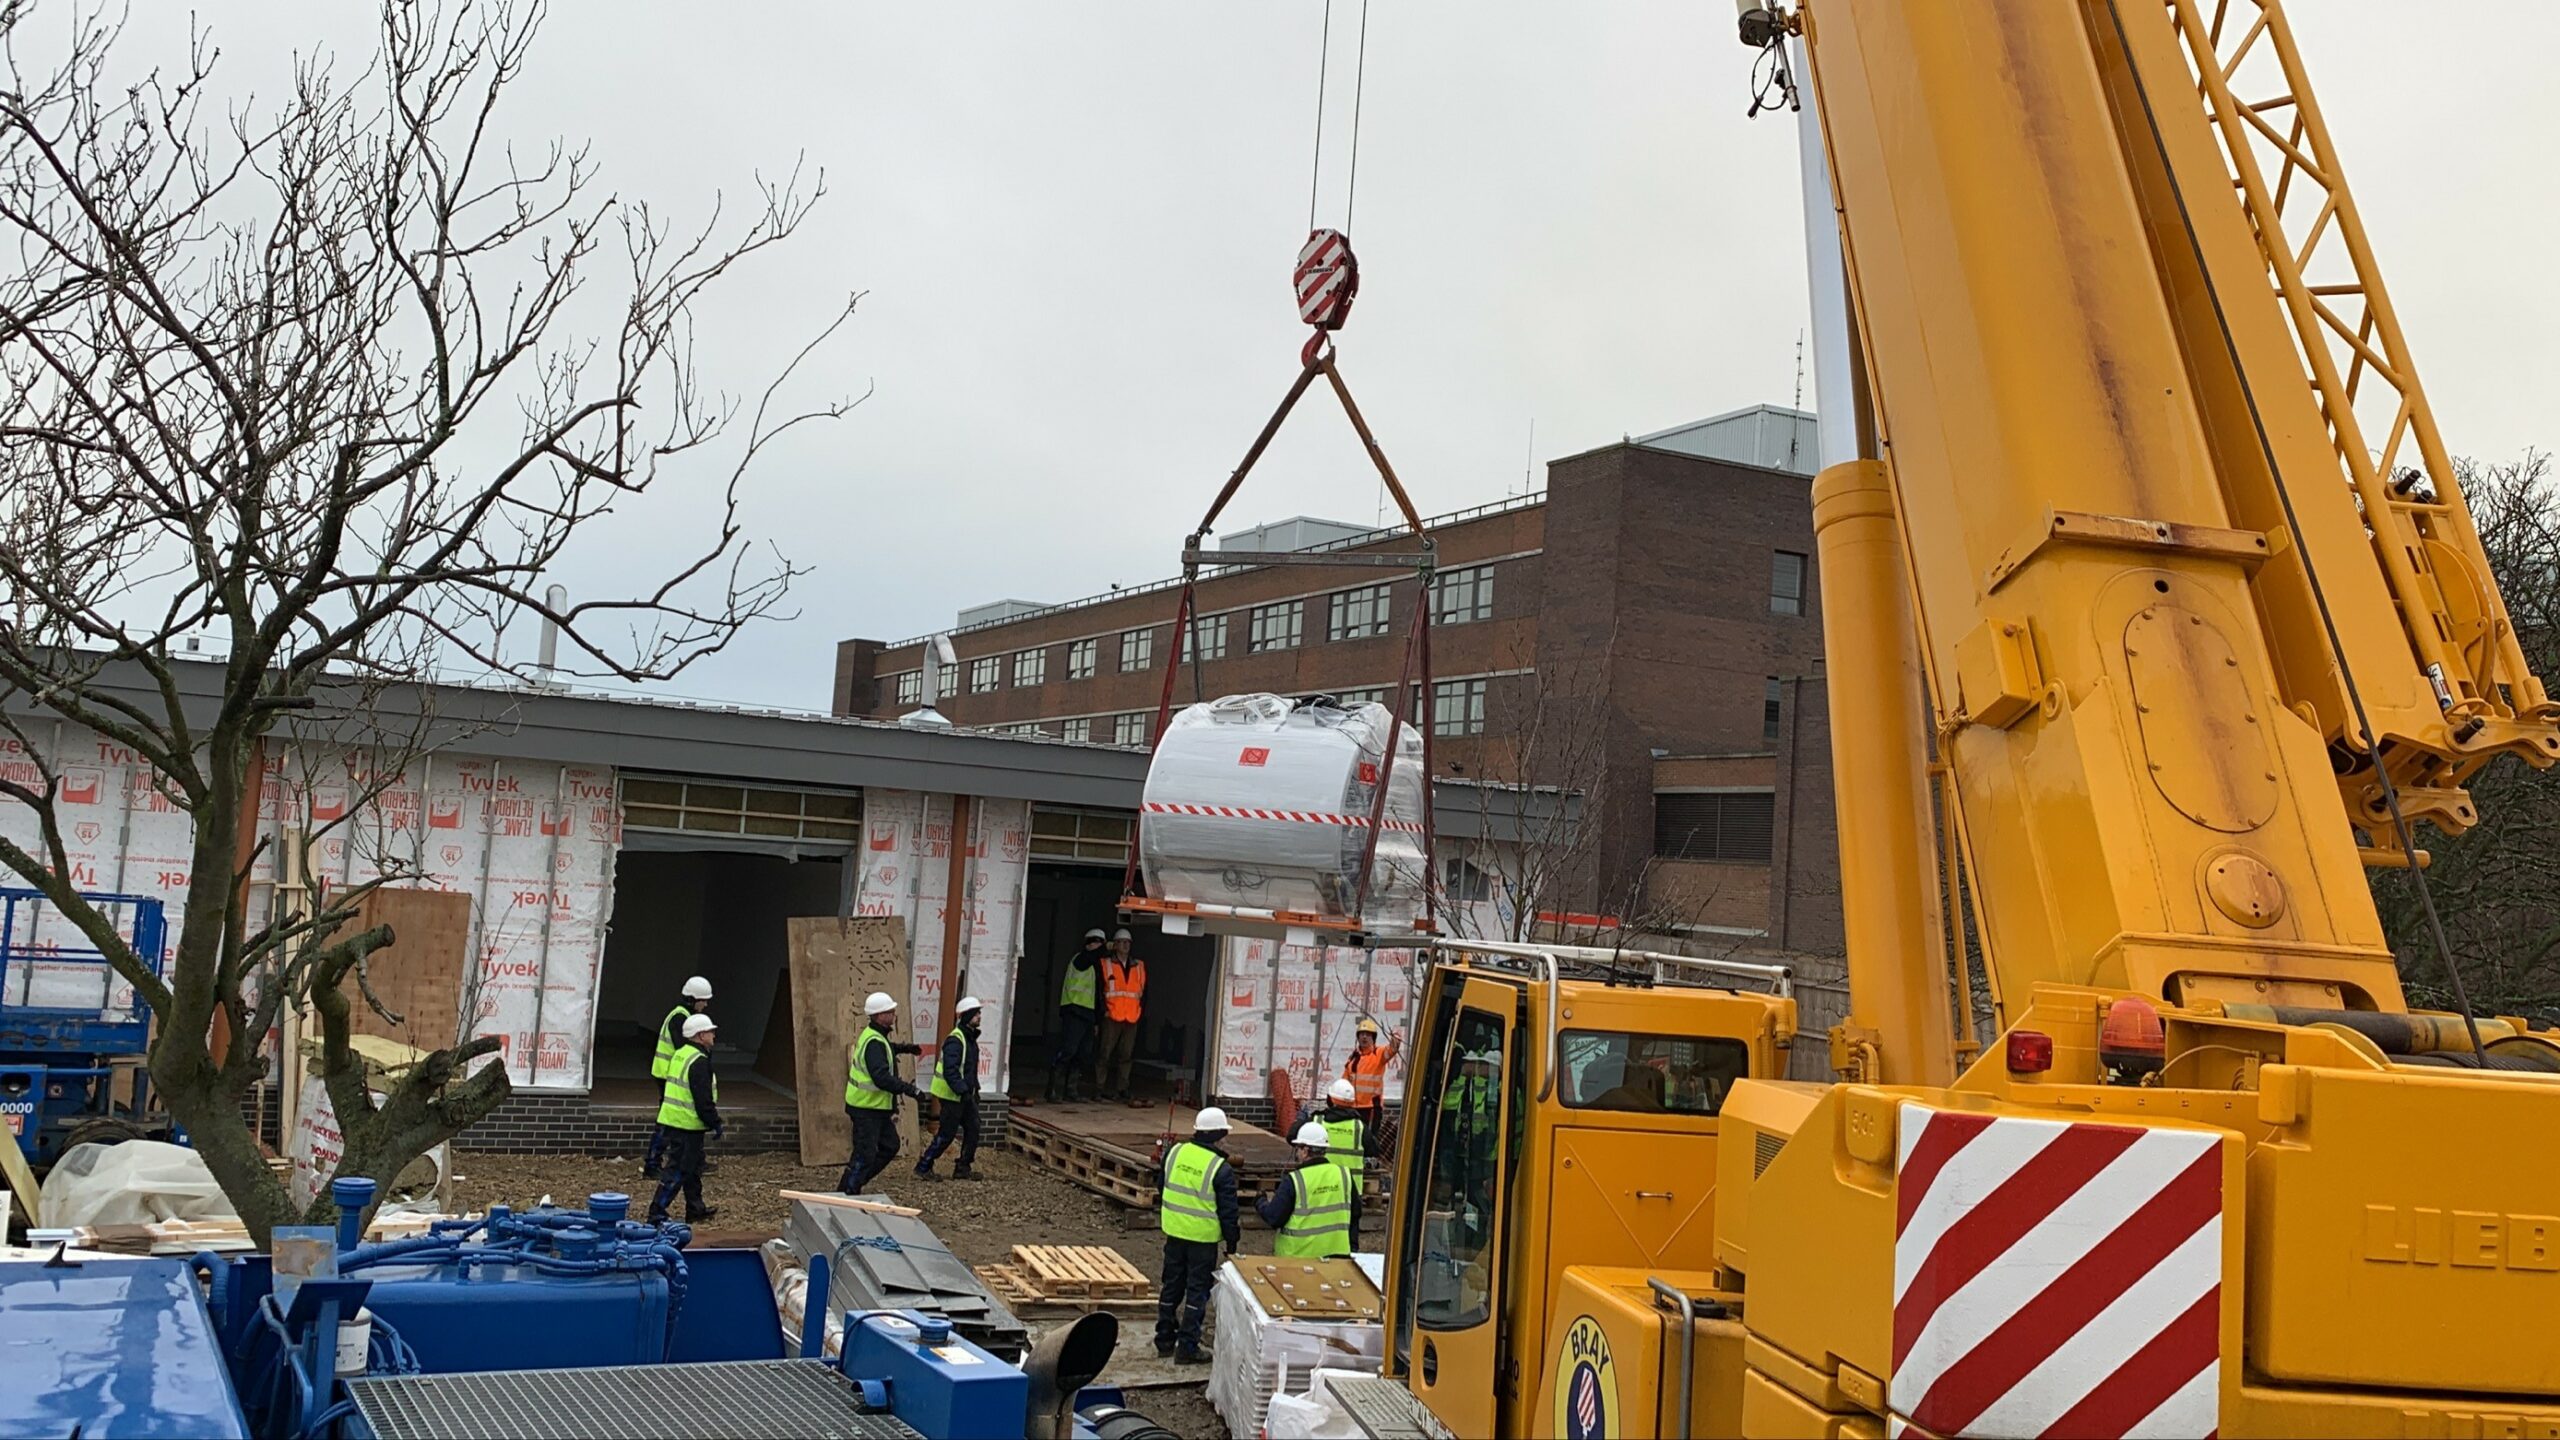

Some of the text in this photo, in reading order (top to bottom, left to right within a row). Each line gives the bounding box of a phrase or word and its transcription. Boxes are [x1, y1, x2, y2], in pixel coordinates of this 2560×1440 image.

[459, 772, 520, 793] Tyvek
[569, 780, 614, 798] Tyve
[481, 799, 534, 818] RETARDAT
[503, 818, 532, 837] FLAME
[65, 851, 96, 861] FireCur
[929, 841, 950, 858] LAME
[512, 890, 571, 910] Tyvek
[480, 957, 540, 978] Tyvek
[516, 1051, 569, 1069] RERDANT
[1224, 1053, 1255, 1071] Tyve
[1571, 1323, 1610, 1375] BRAY
